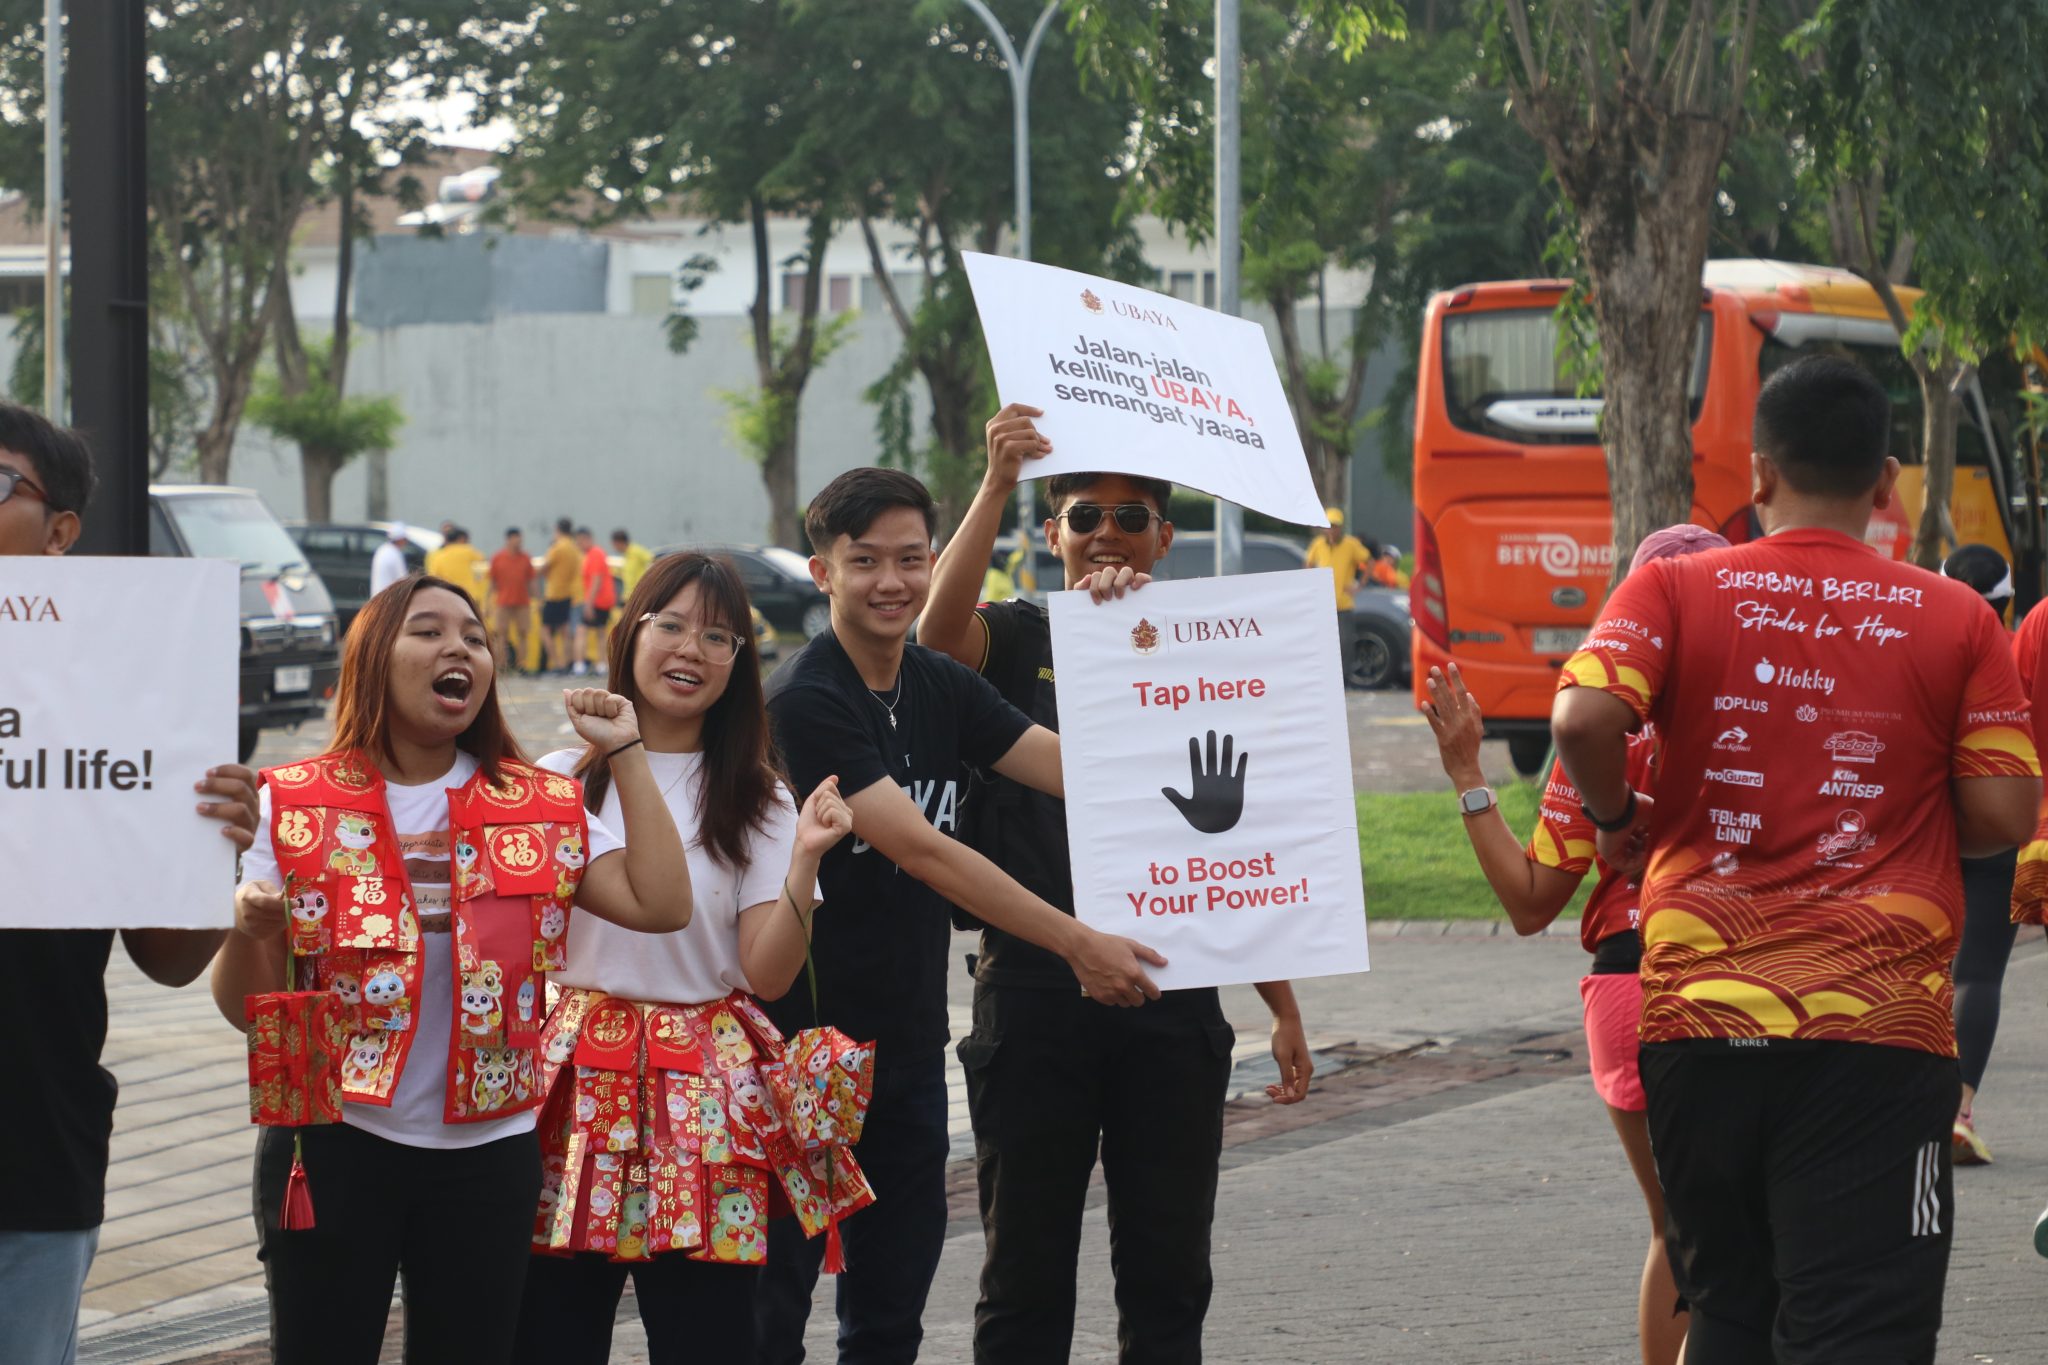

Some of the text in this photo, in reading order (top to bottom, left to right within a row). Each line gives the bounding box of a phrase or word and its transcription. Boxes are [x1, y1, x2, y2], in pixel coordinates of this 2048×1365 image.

[1111, 299, 1178, 331] UBAYA
[1074, 335, 1212, 386] Jalan-jalan
[1050, 354, 1254, 427] keliling UBAYA,
[1054, 383, 1265, 450] semangat yaaaa
[1716, 568, 1923, 607] SURABAYA BERLARI
[1174, 617, 1263, 644] UBAYA
[1735, 601, 1909, 646] Strides for Hope
[1133, 677, 1266, 711] Tap here
[1777, 667, 1835, 695] Hokky
[1714, 696, 1769, 713] ISOPLUS
[1823, 737, 1886, 753] Sedaap
[0, 749, 153, 790] ul life!
[1704, 769, 1764, 788] ProGuard
[1832, 769, 1859, 782] Klin
[1818, 782, 1885, 799] ANTISEP
[277, 810, 313, 848] 福
[500, 832, 538, 866] 福
[1148, 852, 1275, 885] to Boost
[351, 876, 387, 905] 福
[1127, 878, 1309, 917] Your Power!
[1729, 1038, 1769, 1048] TERREX
